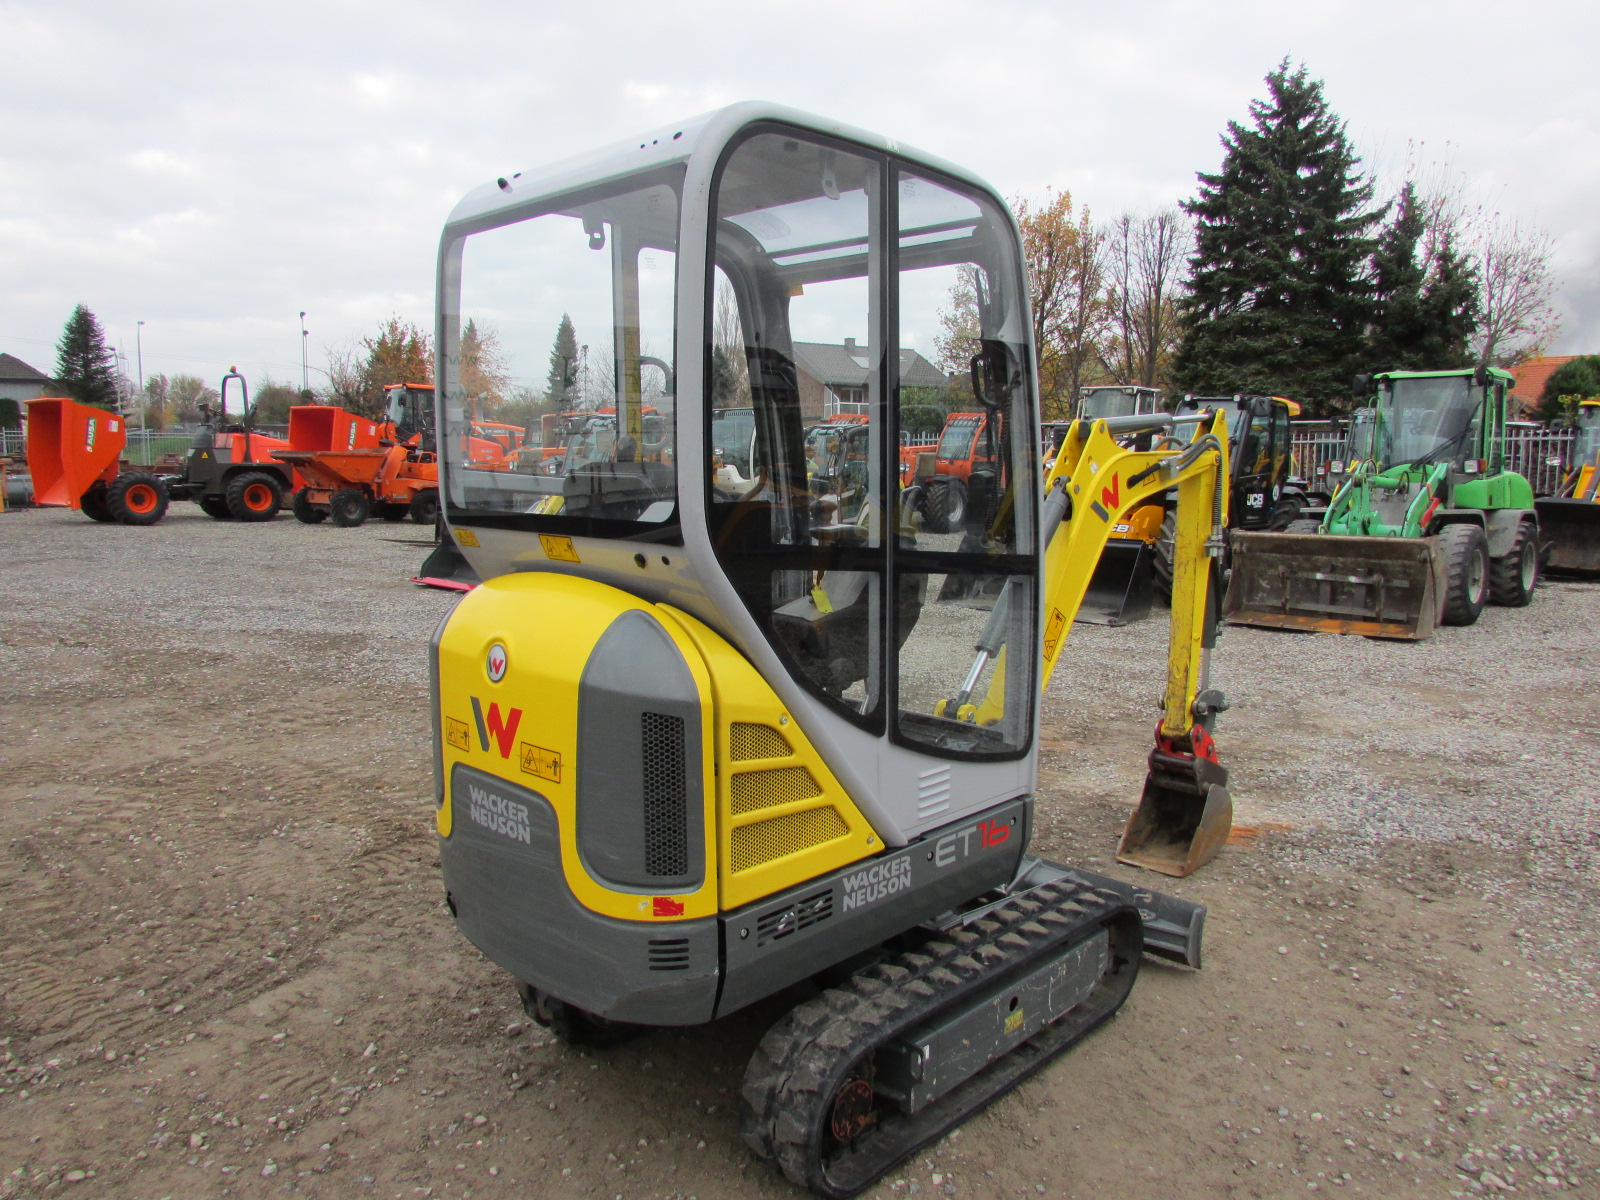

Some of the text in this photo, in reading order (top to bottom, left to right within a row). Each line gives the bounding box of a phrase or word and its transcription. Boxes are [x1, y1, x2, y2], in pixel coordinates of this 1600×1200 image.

[87, 418, 96, 445] AUSA
[1246, 493, 1264, 505] JCB
[469, 784, 529, 825] WACKER
[471, 803, 530, 844] NEUSON
[936, 819, 1009, 867] ET16
[843, 856, 911, 893] WACKER
[843, 871, 911, 912] NEUSON
